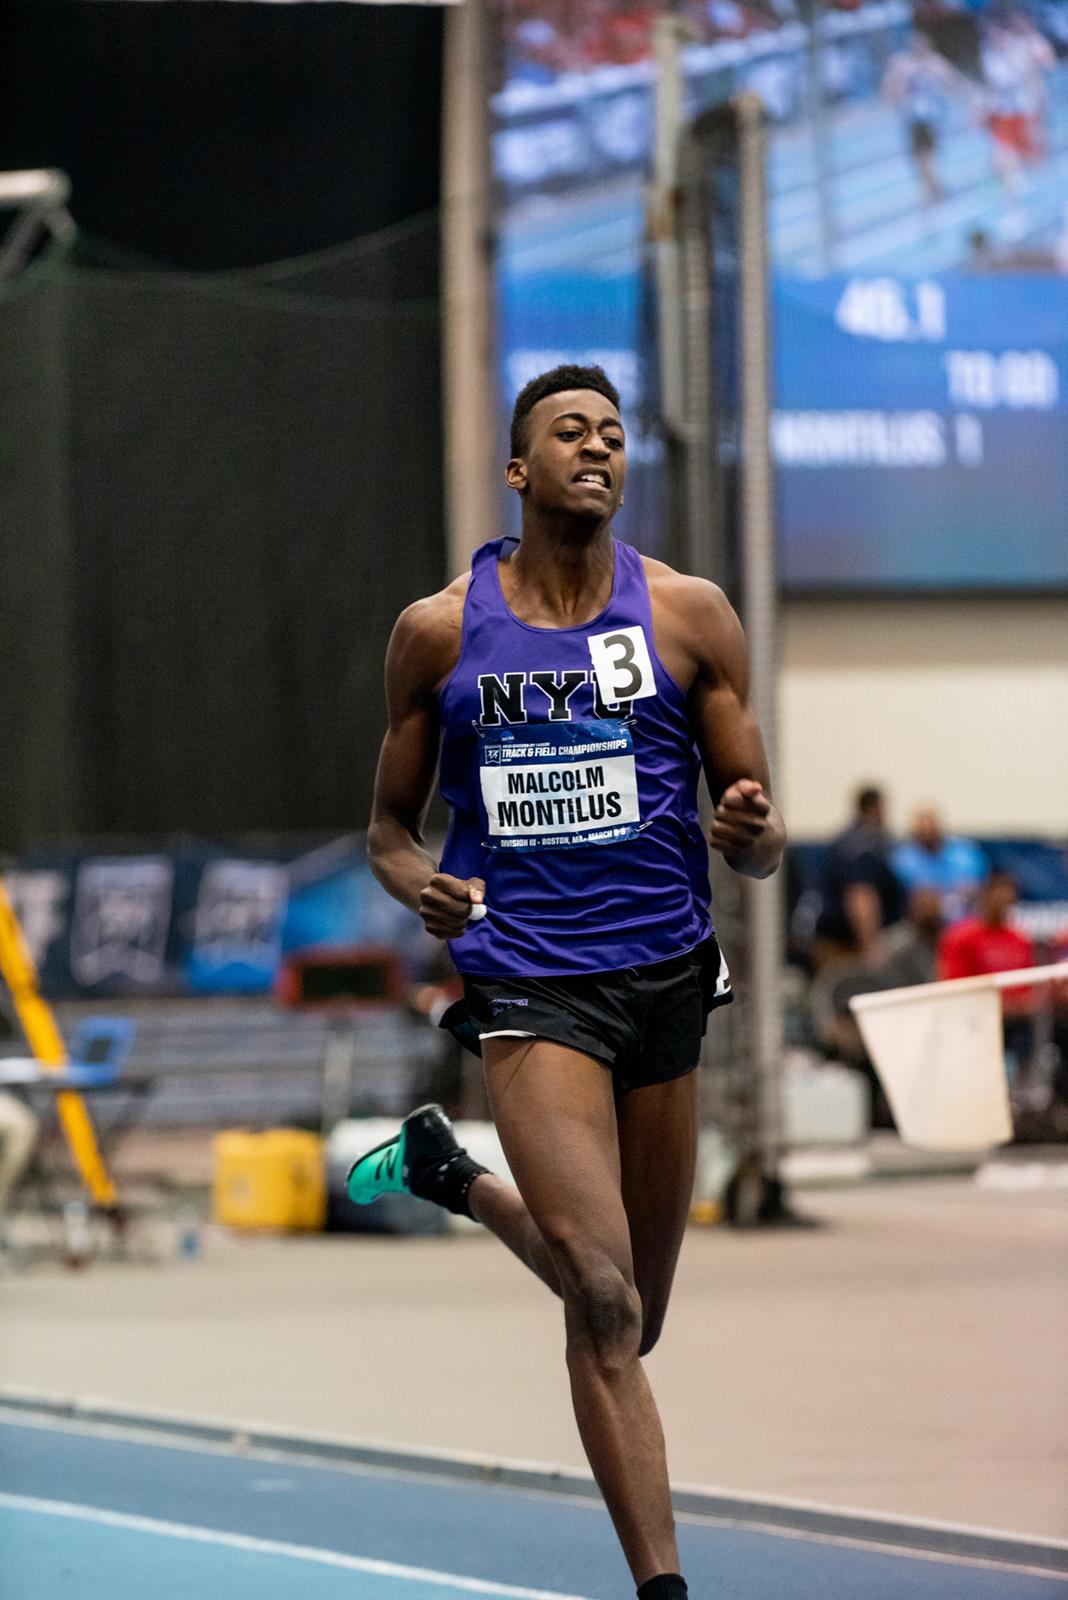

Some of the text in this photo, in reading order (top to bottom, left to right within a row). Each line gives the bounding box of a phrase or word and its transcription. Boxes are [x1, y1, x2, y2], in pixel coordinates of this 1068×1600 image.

[603, 633, 643, 699] 3
[502, 748, 527, 758] TRACK
[527, 748, 534, 757] &
[535, 746, 557, 757] FIELD
[558, 739, 627, 756] CHAMPIONSHIPS
[508, 766, 605, 794] MALCOLM
[497, 791, 622, 828] MONTILUS
[500, 839, 528, 847] DIVISION
